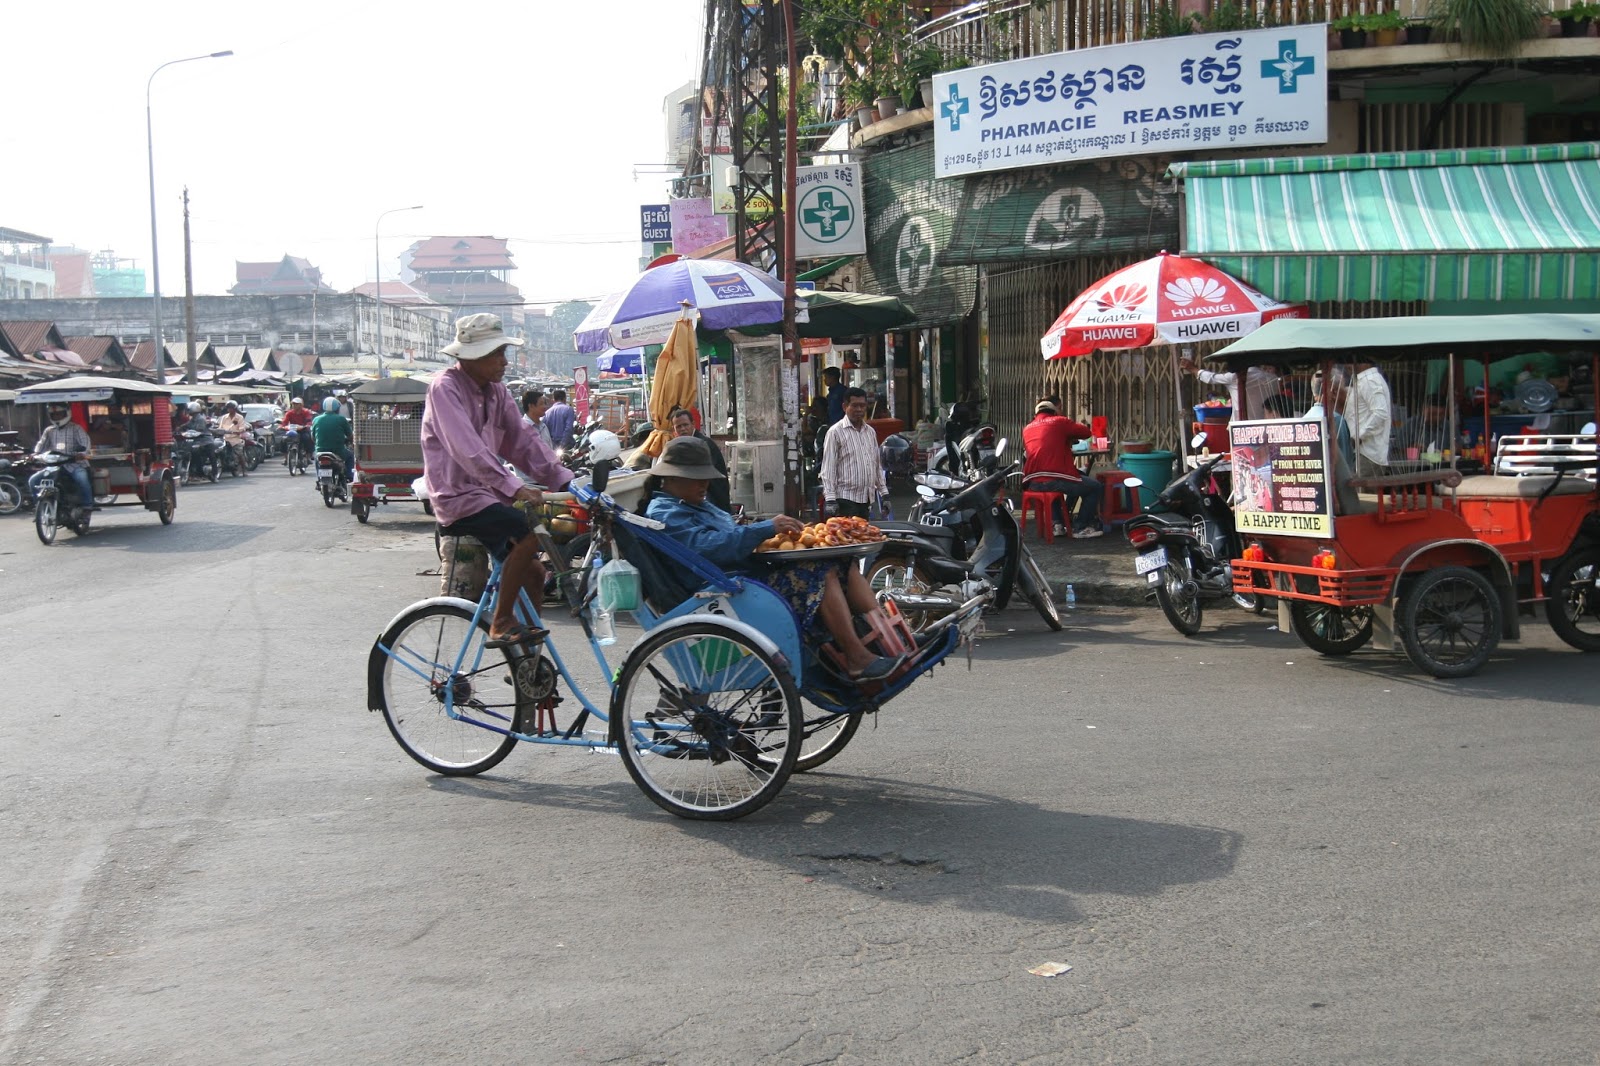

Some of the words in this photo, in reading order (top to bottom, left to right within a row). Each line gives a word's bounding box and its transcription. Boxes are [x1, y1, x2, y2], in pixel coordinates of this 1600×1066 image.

[981, 115, 1097, 142] PHARMACIE
[1123, 101, 1245, 125] REASMEY
[1014, 143, 1032, 156] 144
[643, 228, 668, 239] GUEST
[1171, 304, 1236, 318] HUAWEI
[1087, 313, 1142, 324] HUAWEI
[1082, 327, 1137, 342] HUAWEI
[1178, 320, 1240, 337] HUAWEI
[1232, 426, 1265, 445] HAPPY
[1266, 424, 1294, 443] TIME
[1295, 423, 1320, 443] BAR
[1280, 446, 1300, 456] STREET
[1278, 460, 1293, 469] FROM
[1293, 460, 1305, 469] THE
[1305, 460, 1322, 470] RIVER
[1272, 473, 1296, 485] Everybody
[1296, 473, 1323, 483] WELCOME
[1243, 514, 1250, 527] A
[1252, 514, 1288, 529] HAPPY
[1291, 516, 1321, 531] TIME
